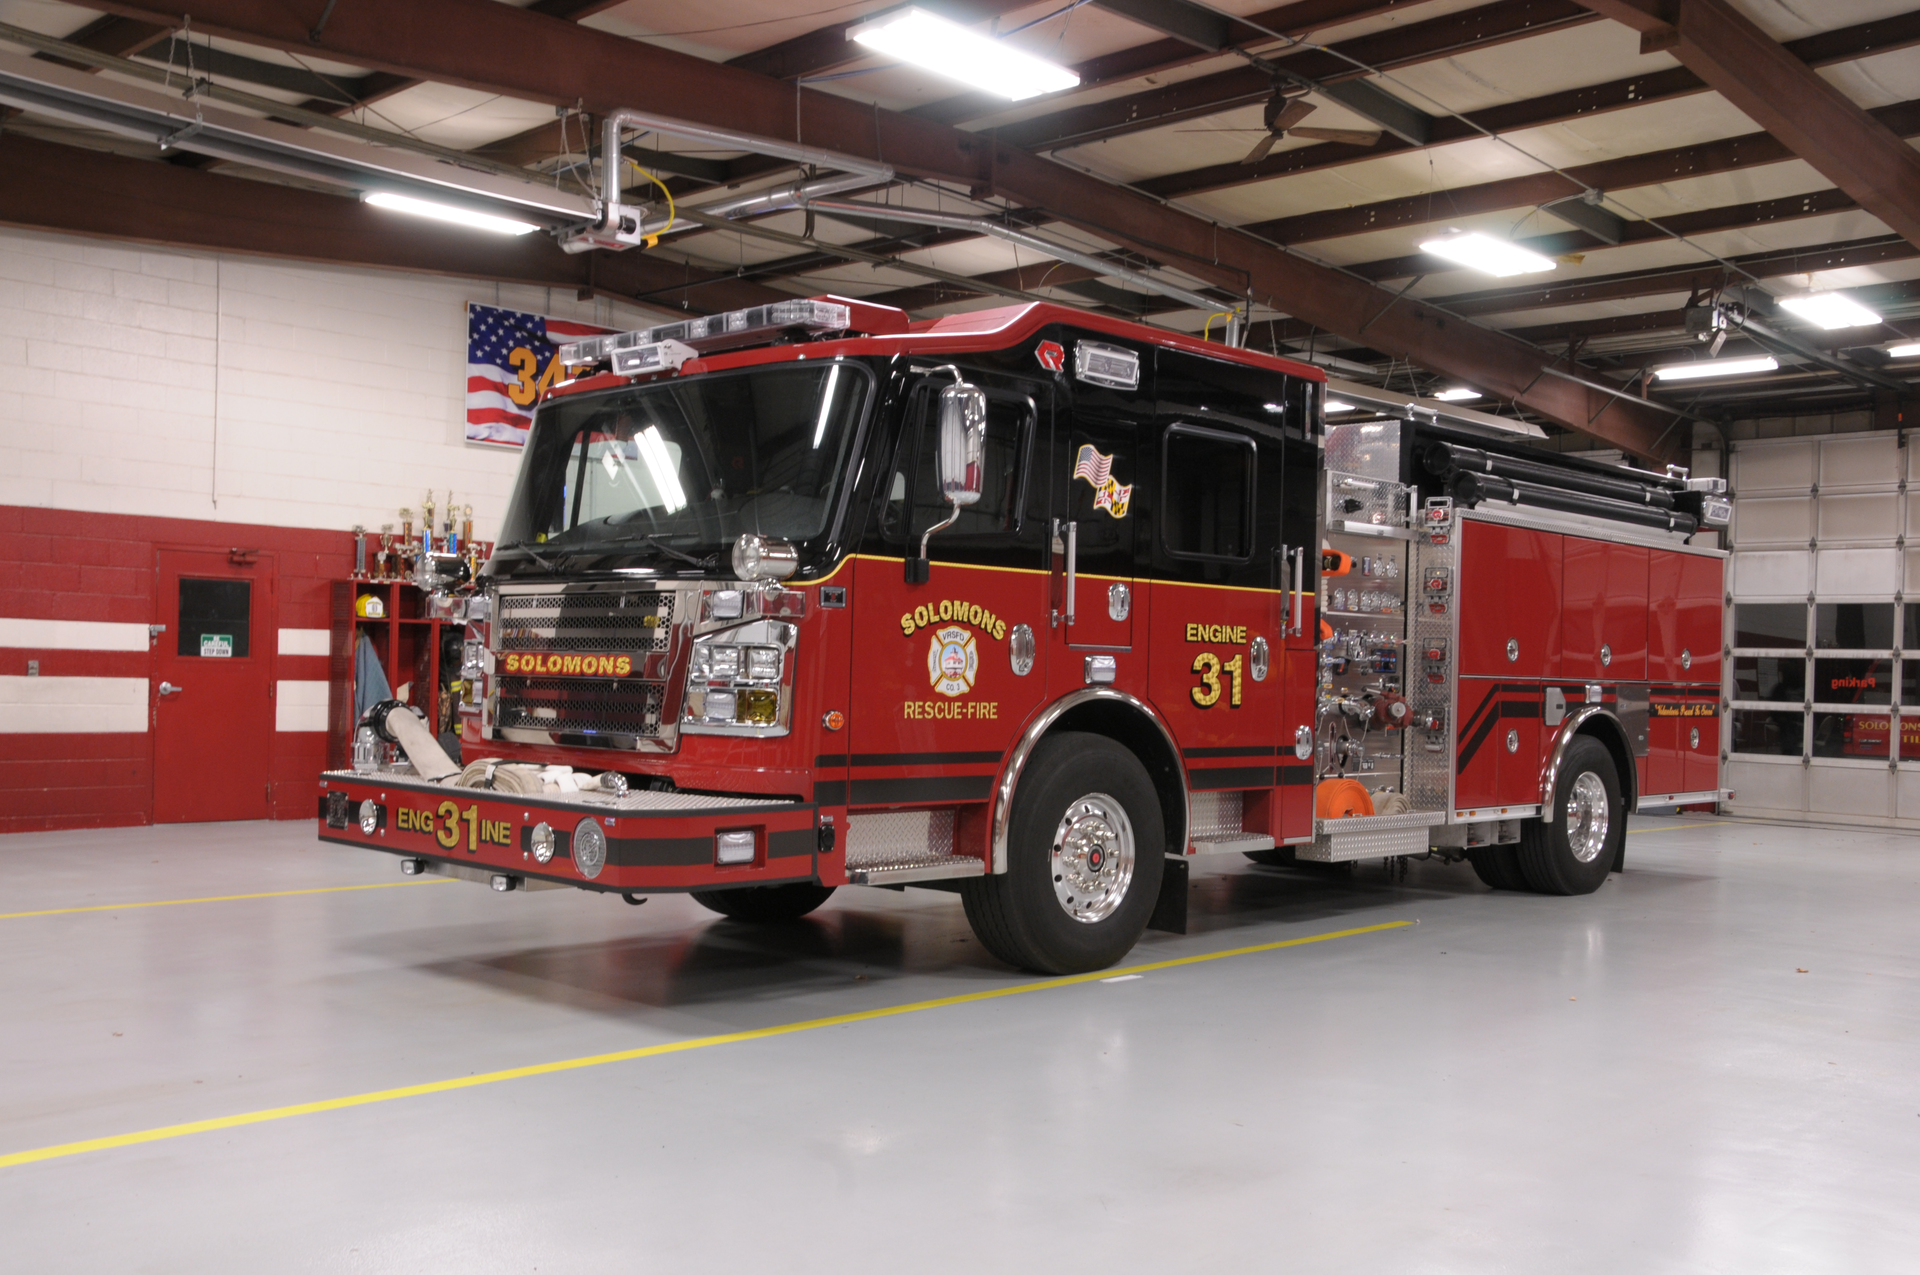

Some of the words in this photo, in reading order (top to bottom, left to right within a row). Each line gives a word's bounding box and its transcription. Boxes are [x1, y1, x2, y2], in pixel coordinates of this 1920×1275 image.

[508, 346, 592, 407] 34
[900, 600, 1007, 641] SOLOMONS
[1185, 622, 1247, 644] ENGINE
[505, 652, 632, 676] SOLOMONS
[1190, 652, 1243, 710] 31
[904, 701, 999, 719] RESCUE-FIRE
[435, 800, 478, 851] 31
